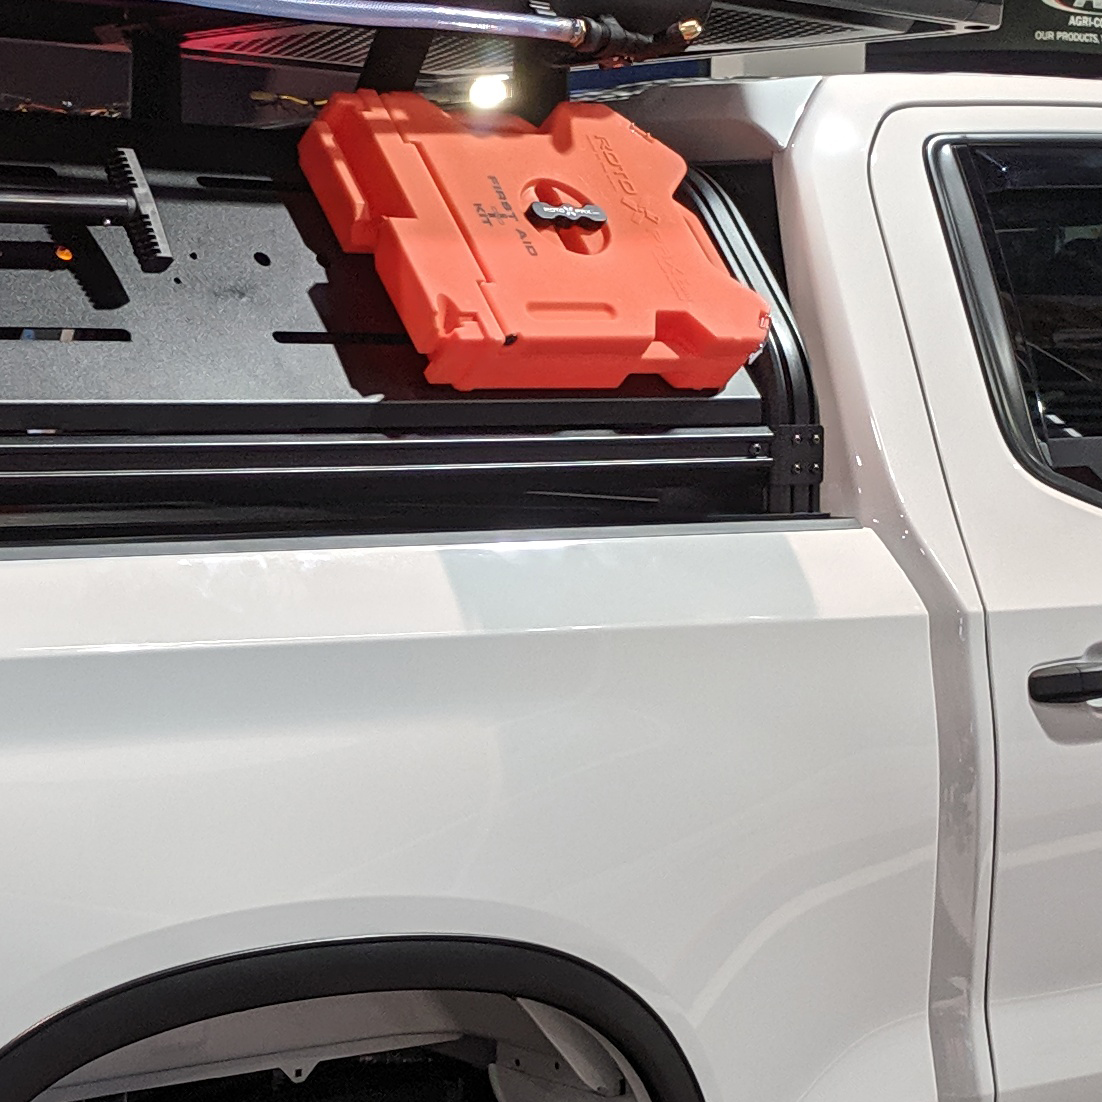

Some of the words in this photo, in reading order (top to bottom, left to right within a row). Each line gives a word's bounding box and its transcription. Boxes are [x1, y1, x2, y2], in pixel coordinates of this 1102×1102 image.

[1034, 30, 1055, 41] OUR
[473, 203, 493, 227] KIT
[487, 175, 518, 222] FIRST
[515, 227, 538, 257] AID
